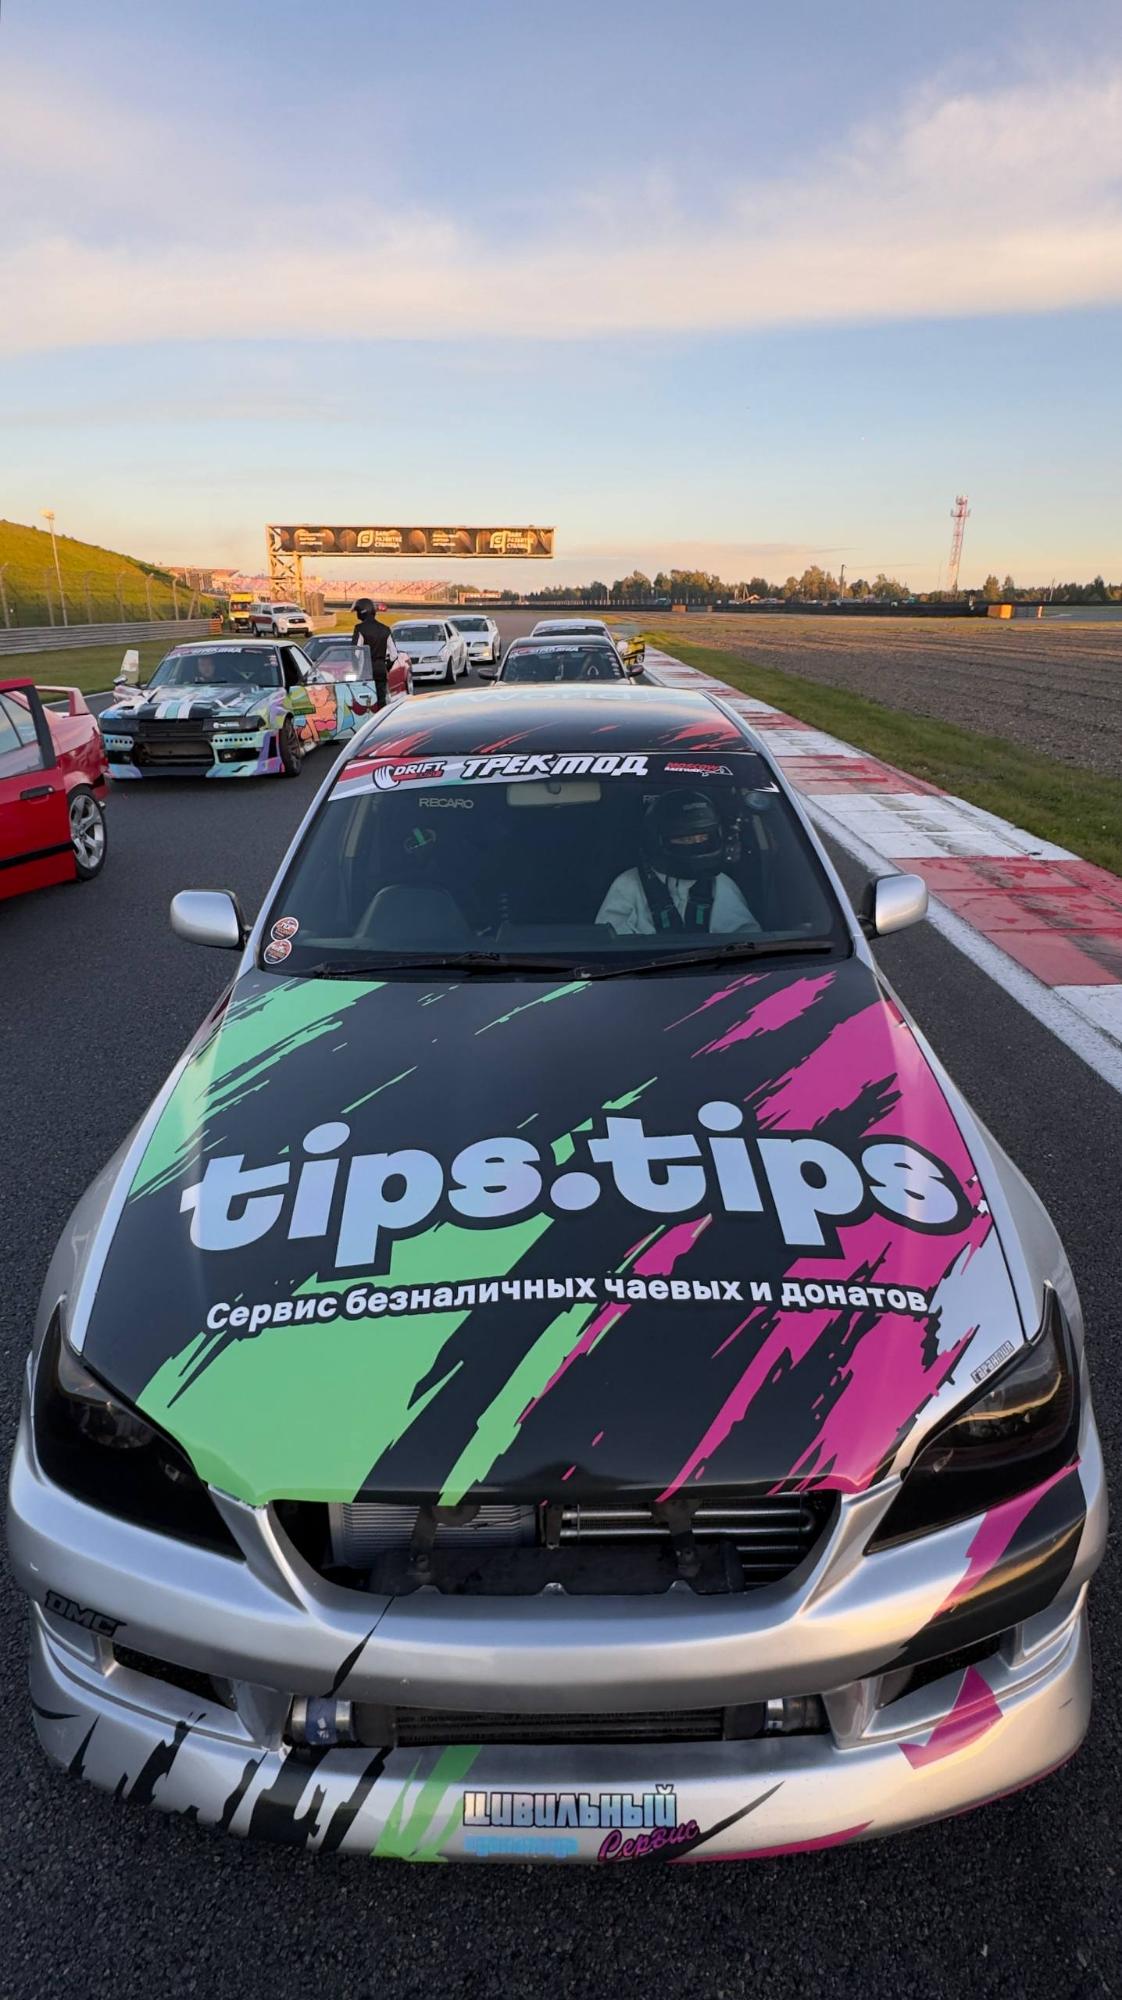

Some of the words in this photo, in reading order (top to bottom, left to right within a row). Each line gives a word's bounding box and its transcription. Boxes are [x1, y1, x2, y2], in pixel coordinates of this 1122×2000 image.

[393, 762, 446, 776] DRIFT
[418, 797, 474, 809] RECARO
[180, 1101, 960, 1268] tips.tips
[207, 1297, 338, 1332] Сервис
[345, 1277, 596, 1314] безналичных
[604, 1276, 743, 1302] чаевых
[750, 1282, 772, 1302] и
[781, 1283, 928, 1313] донатов
[463, 1784, 677, 1829] ЦИВИЛЬНЫЙ
[597, 1819, 701, 1863] Сервис
